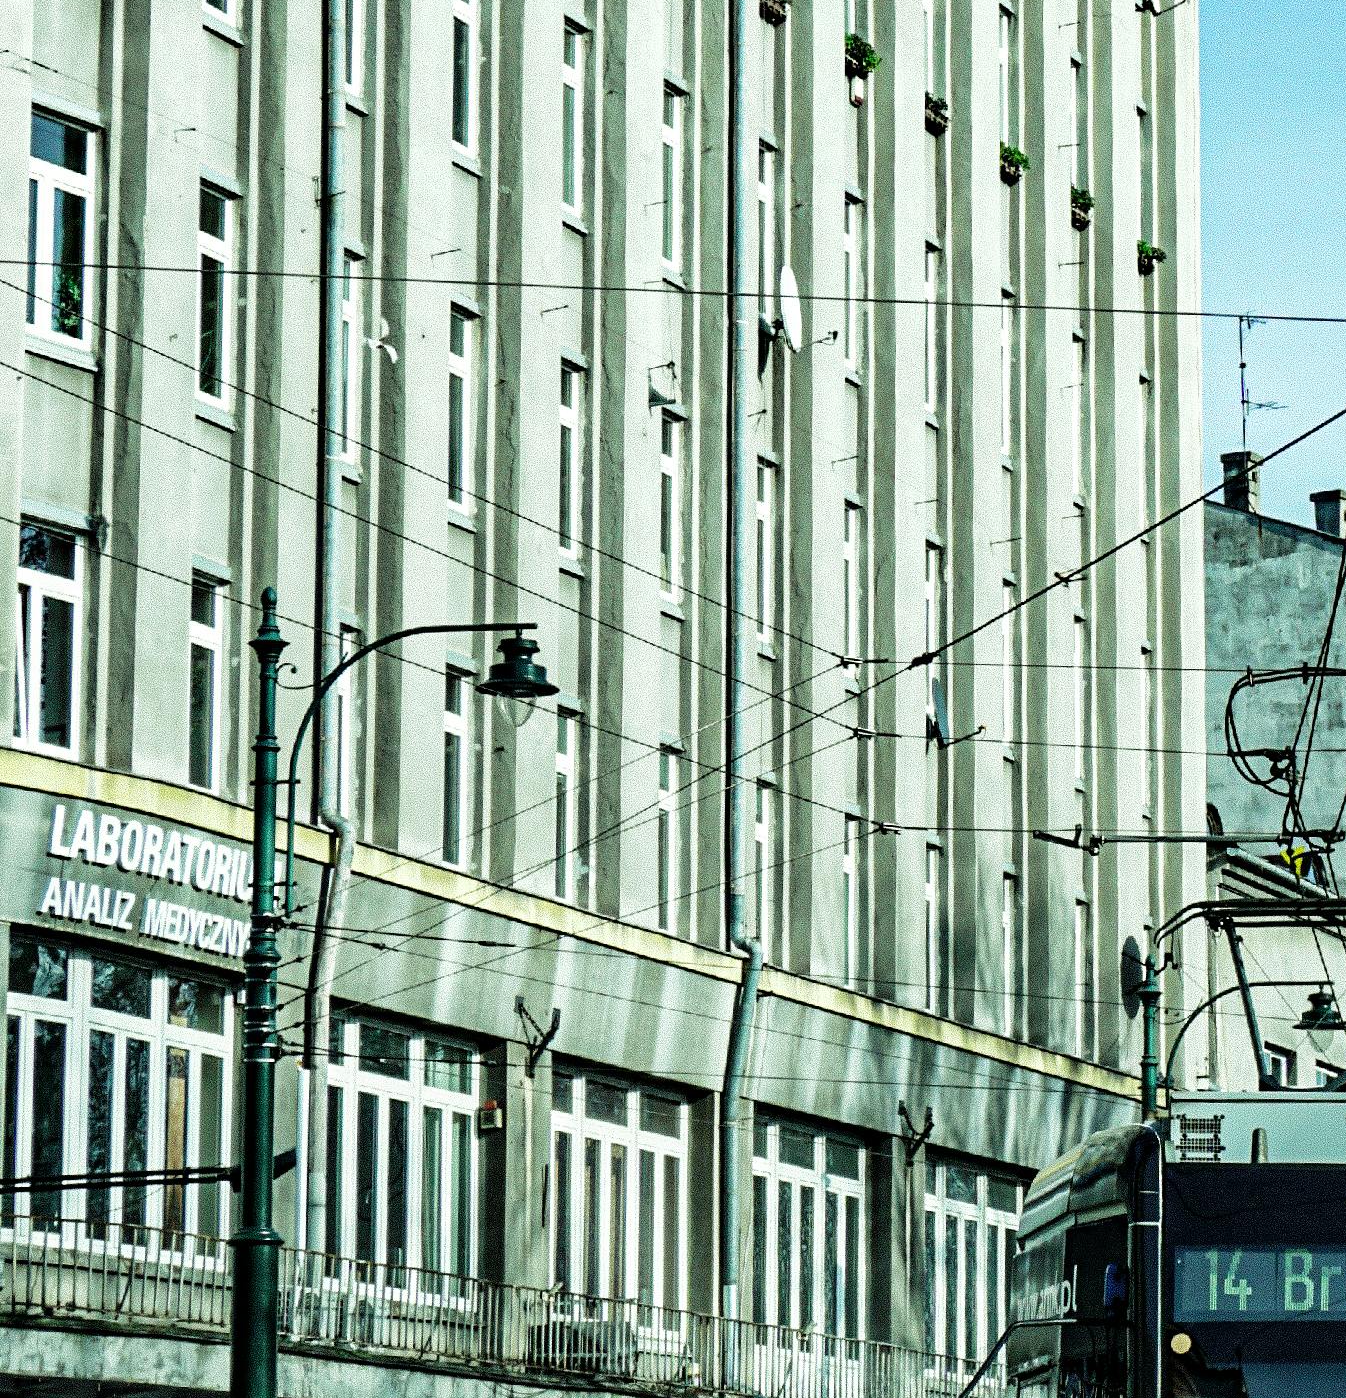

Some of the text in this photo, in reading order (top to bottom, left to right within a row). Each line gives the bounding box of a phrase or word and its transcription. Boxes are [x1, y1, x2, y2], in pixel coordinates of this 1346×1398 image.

[50, 804, 282, 909] LABORATORIU
[41, 877, 251, 957] ANALIZ MEDYCZNY
[1206, 1249, 1252, 1311] 14
